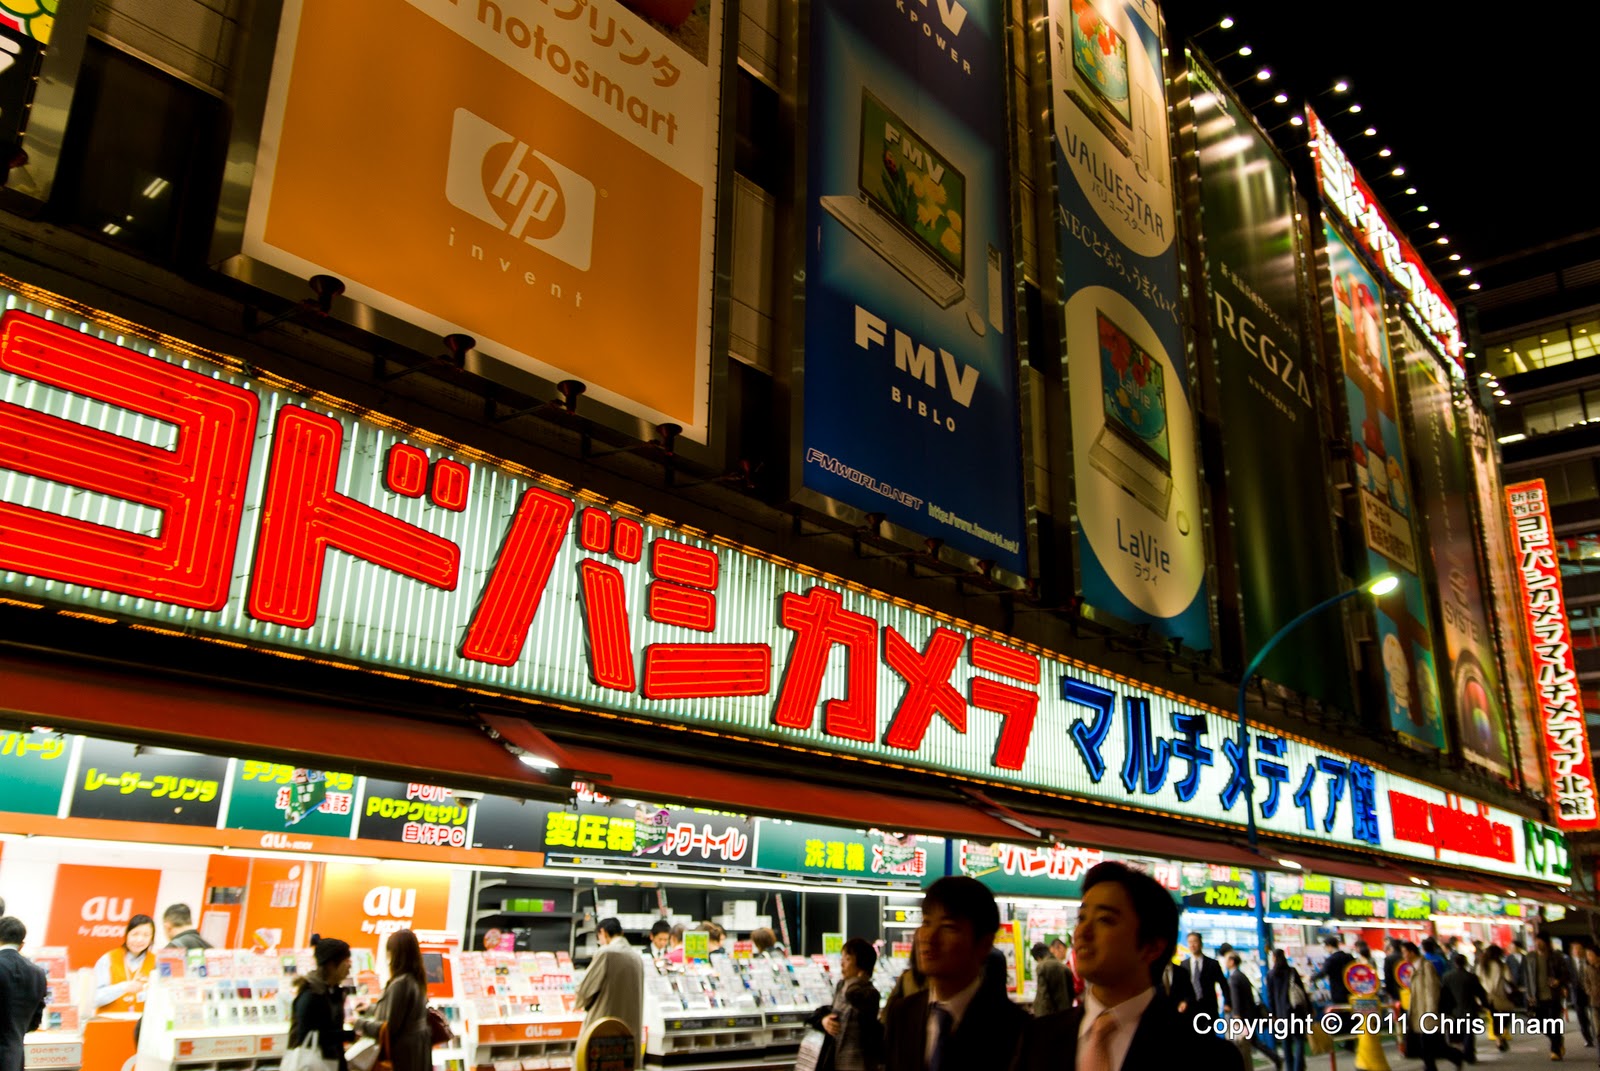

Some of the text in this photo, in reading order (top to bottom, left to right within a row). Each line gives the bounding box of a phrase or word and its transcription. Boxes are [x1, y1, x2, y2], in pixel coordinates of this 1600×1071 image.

[449, 0, 679, 146] hotosmart
[884, 121, 946, 187] FMV
[1064, 125, 1166, 243] VALUESTAR
[491, 139, 559, 240] hp
[448, 227, 583, 308] invent
[855, 304, 980, 409] FMV
[1214, 289, 1314, 409] REGZA
[891, 385, 957, 433] BIBLO
[0, 308, 1040, 771] ヨドバシカメラ
[1117, 517, 1171, 574] LaVie
[242, 759, 355, 792] デジタメラ
[402, 821, 467, 848] 自作PC
[545, 811, 635, 852] 変圧器
[648, 822, 748, 861] ャワートイレ
[81, 895, 133, 922] au
[363, 885, 417, 918] au
